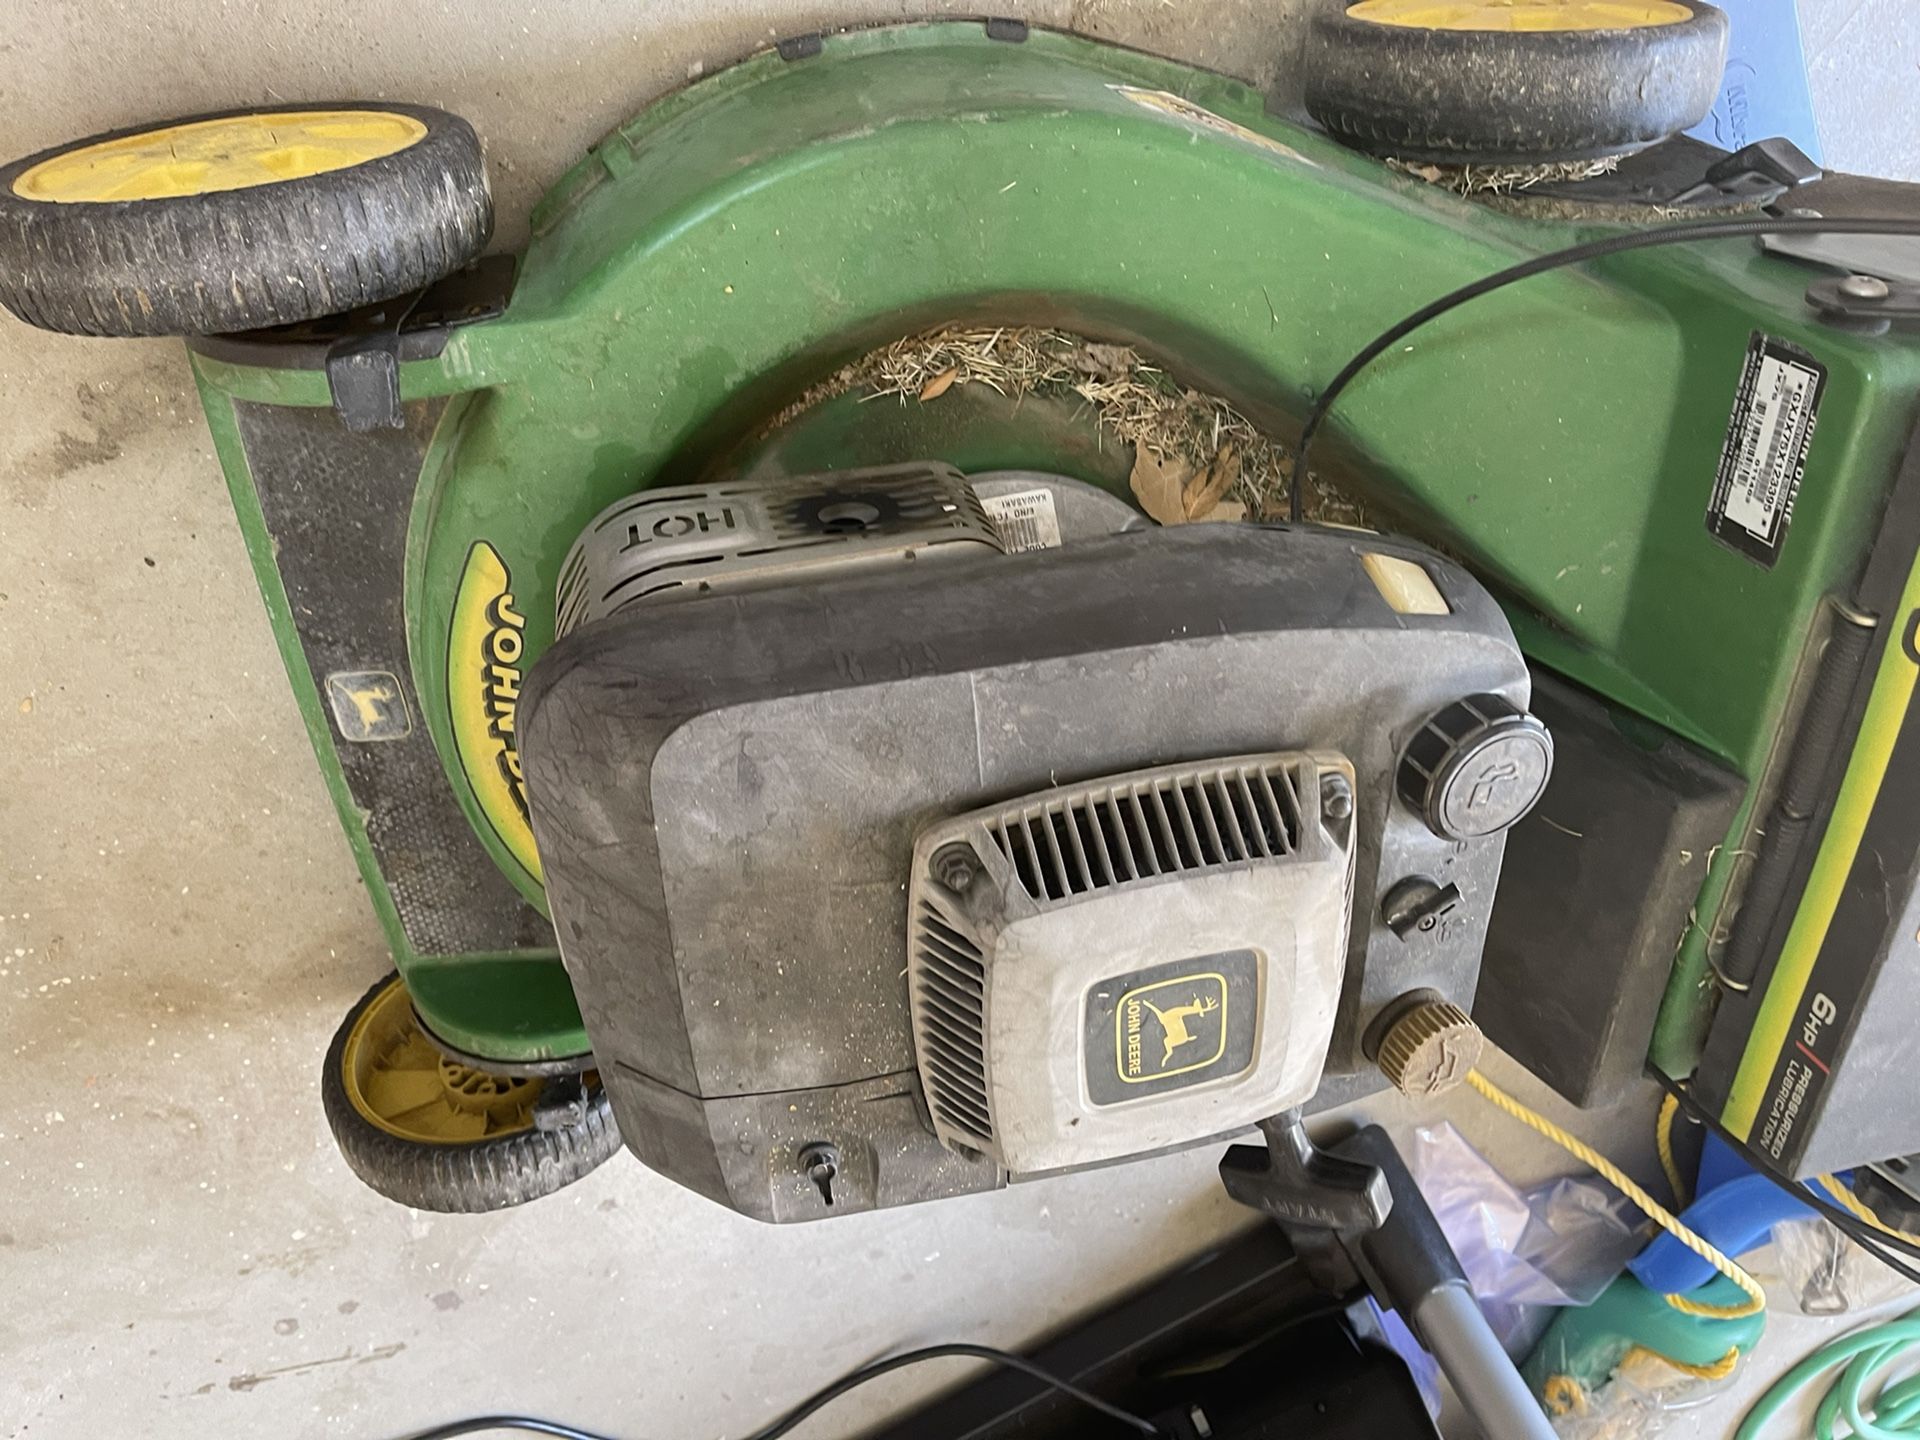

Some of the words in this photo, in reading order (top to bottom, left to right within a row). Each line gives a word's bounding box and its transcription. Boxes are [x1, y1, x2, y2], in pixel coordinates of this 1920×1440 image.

[1799, 409, 1817, 463] JOHN
[1001, 494, 1047, 508] KAWASAKI
[620, 508, 735, 553] HOT
[485, 593, 526, 735] JOHN
[1127, 998, 1141, 1033] JOHN
[1128, 1034, 1142, 1076] DEERE
[1760, 1059, 1799, 1150] LUBRICATION
[1771, 1064, 1813, 1160] PRESSURIZED
